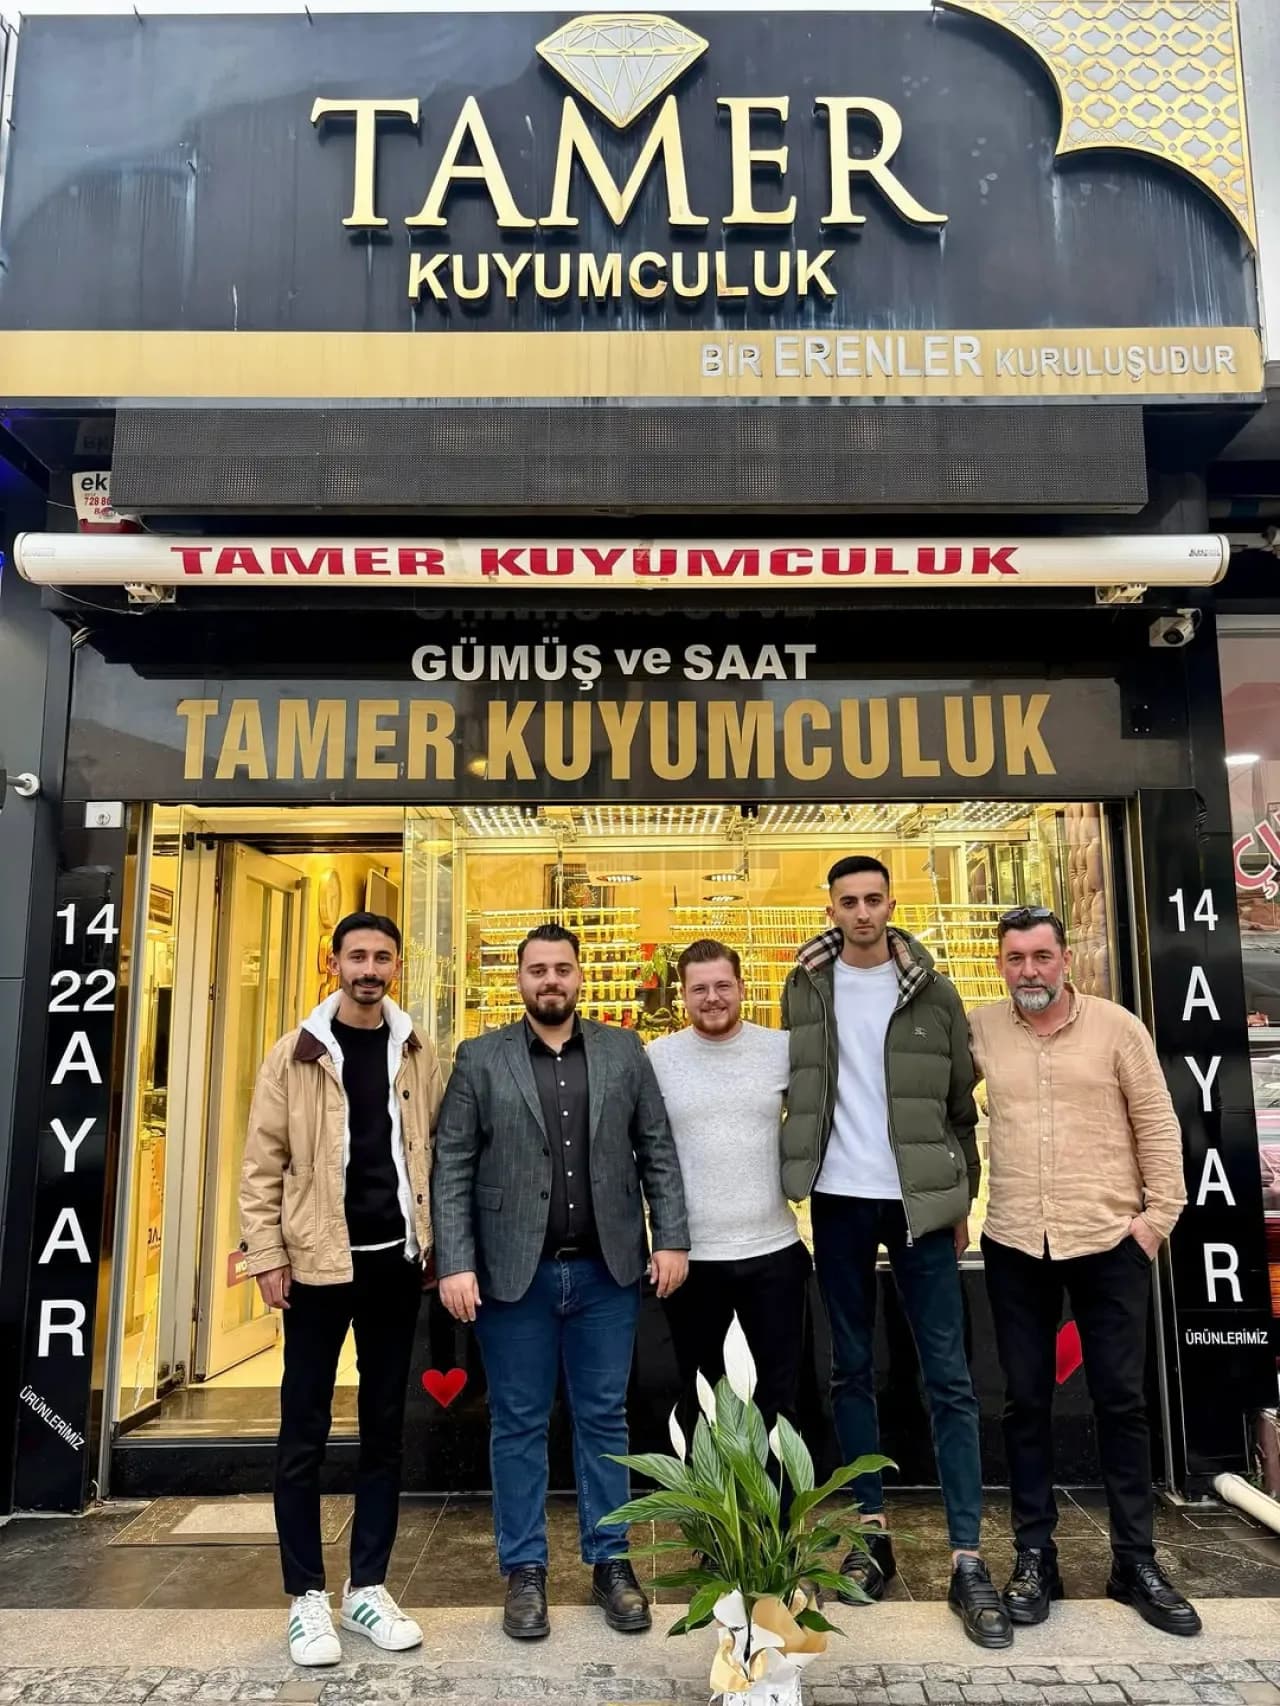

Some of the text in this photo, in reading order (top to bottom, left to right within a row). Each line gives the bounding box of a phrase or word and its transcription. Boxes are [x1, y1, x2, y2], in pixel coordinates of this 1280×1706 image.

[310, 94, 949, 228] TAMER
[408, 249, 838, 300] KUYUMCULUK
[701, 334, 1237, 383] BİR ERENLER KURULUŞUDUR
[170, 546, 1020, 577] TAMER KUYUMCULUK
[411, 637, 817, 691] GÜMÜŞ ve SAAT
[176, 693, 1057, 782] TAMER KUYUMCULUK
[56, 903, 119, 945] 14
[1169, 888, 1219, 932] 14
[48, 968, 116, 1013] 22
[1185, 1328, 1269, 1345] ÜRÜNLERİMİZ
[19, 1384, 87, 1451] ÜRÜNLERİMİZ
